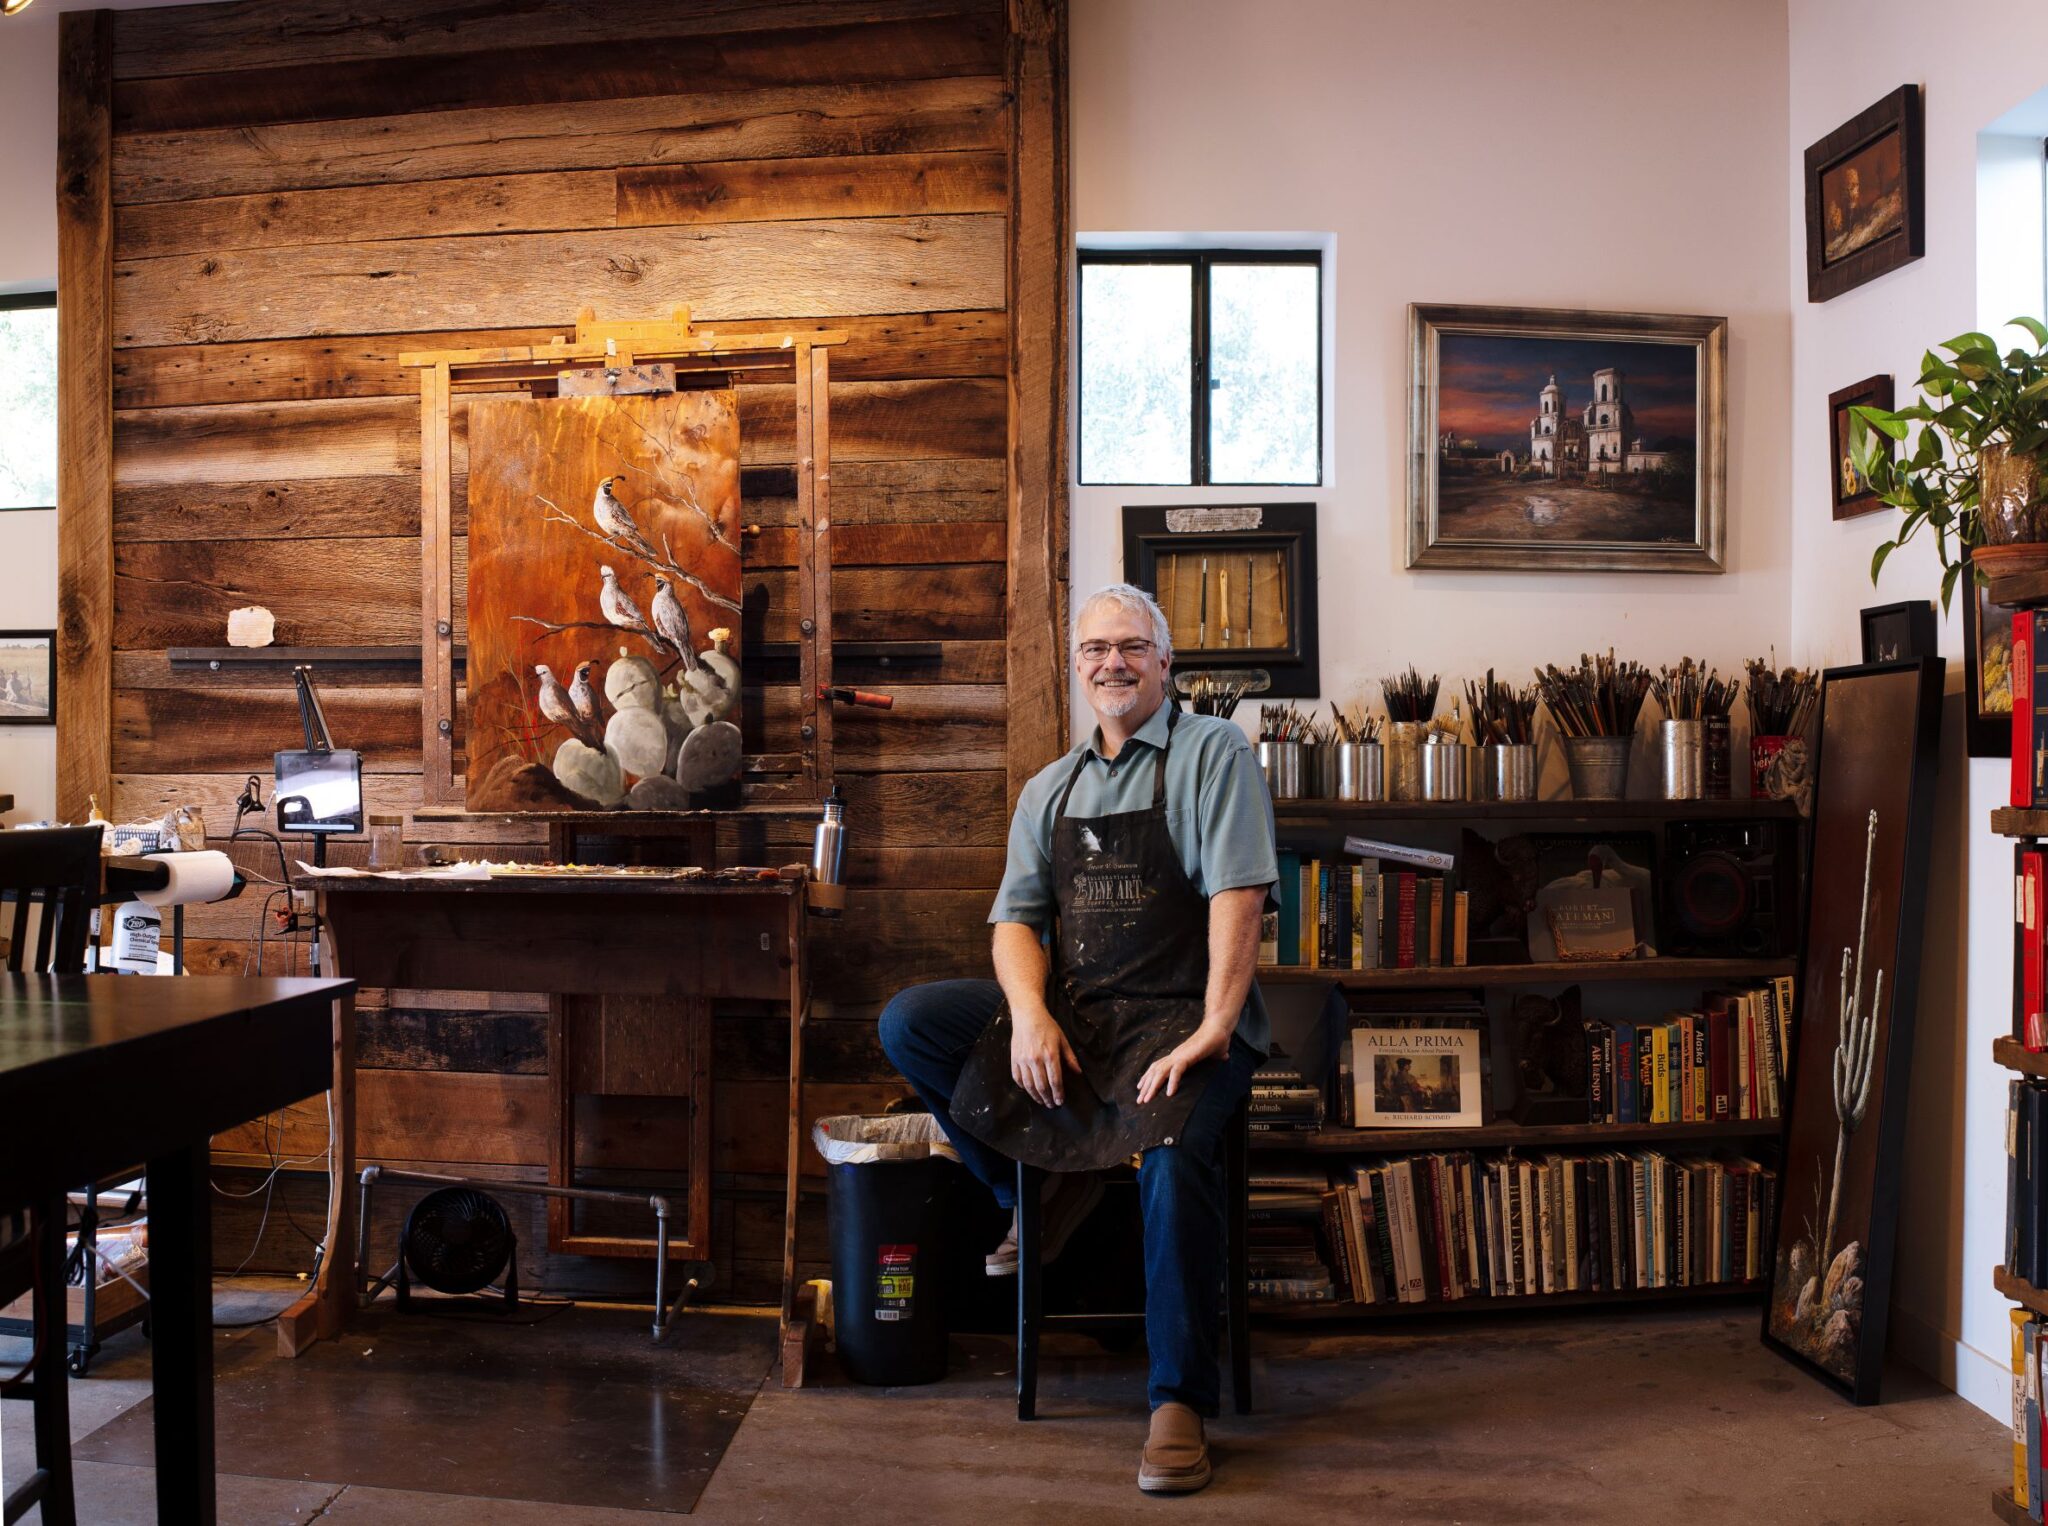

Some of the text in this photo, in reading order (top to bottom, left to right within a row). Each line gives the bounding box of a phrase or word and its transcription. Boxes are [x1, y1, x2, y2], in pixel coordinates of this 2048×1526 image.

[1088, 879, 1143, 900] FINE ART
[1762, 994, 1773, 1040] DRAWING
[1368, 1036, 1464, 1047] ALLA PRIMA
[1695, 1030, 1703, 1063] Alaska
[1766, 1043, 1774, 1052] IN
[1591, 1044, 1601, 1101] ART ENJOY
[1617, 1041, 1633, 1081] Weird
[1640, 1054, 1652, 1085] Weird
[1656, 1053, 1666, 1077] Birds
[1767, 1056, 1775, 1072] INK
[1268, 1091, 1290, 1099] Book
[1253, 1104, 1281, 1112] Animals
[1553, 1166, 1561, 1191] Charles
[1509, 1184, 1523, 1264] HUNTING
[1554, 1202, 1562, 1224] Russell
